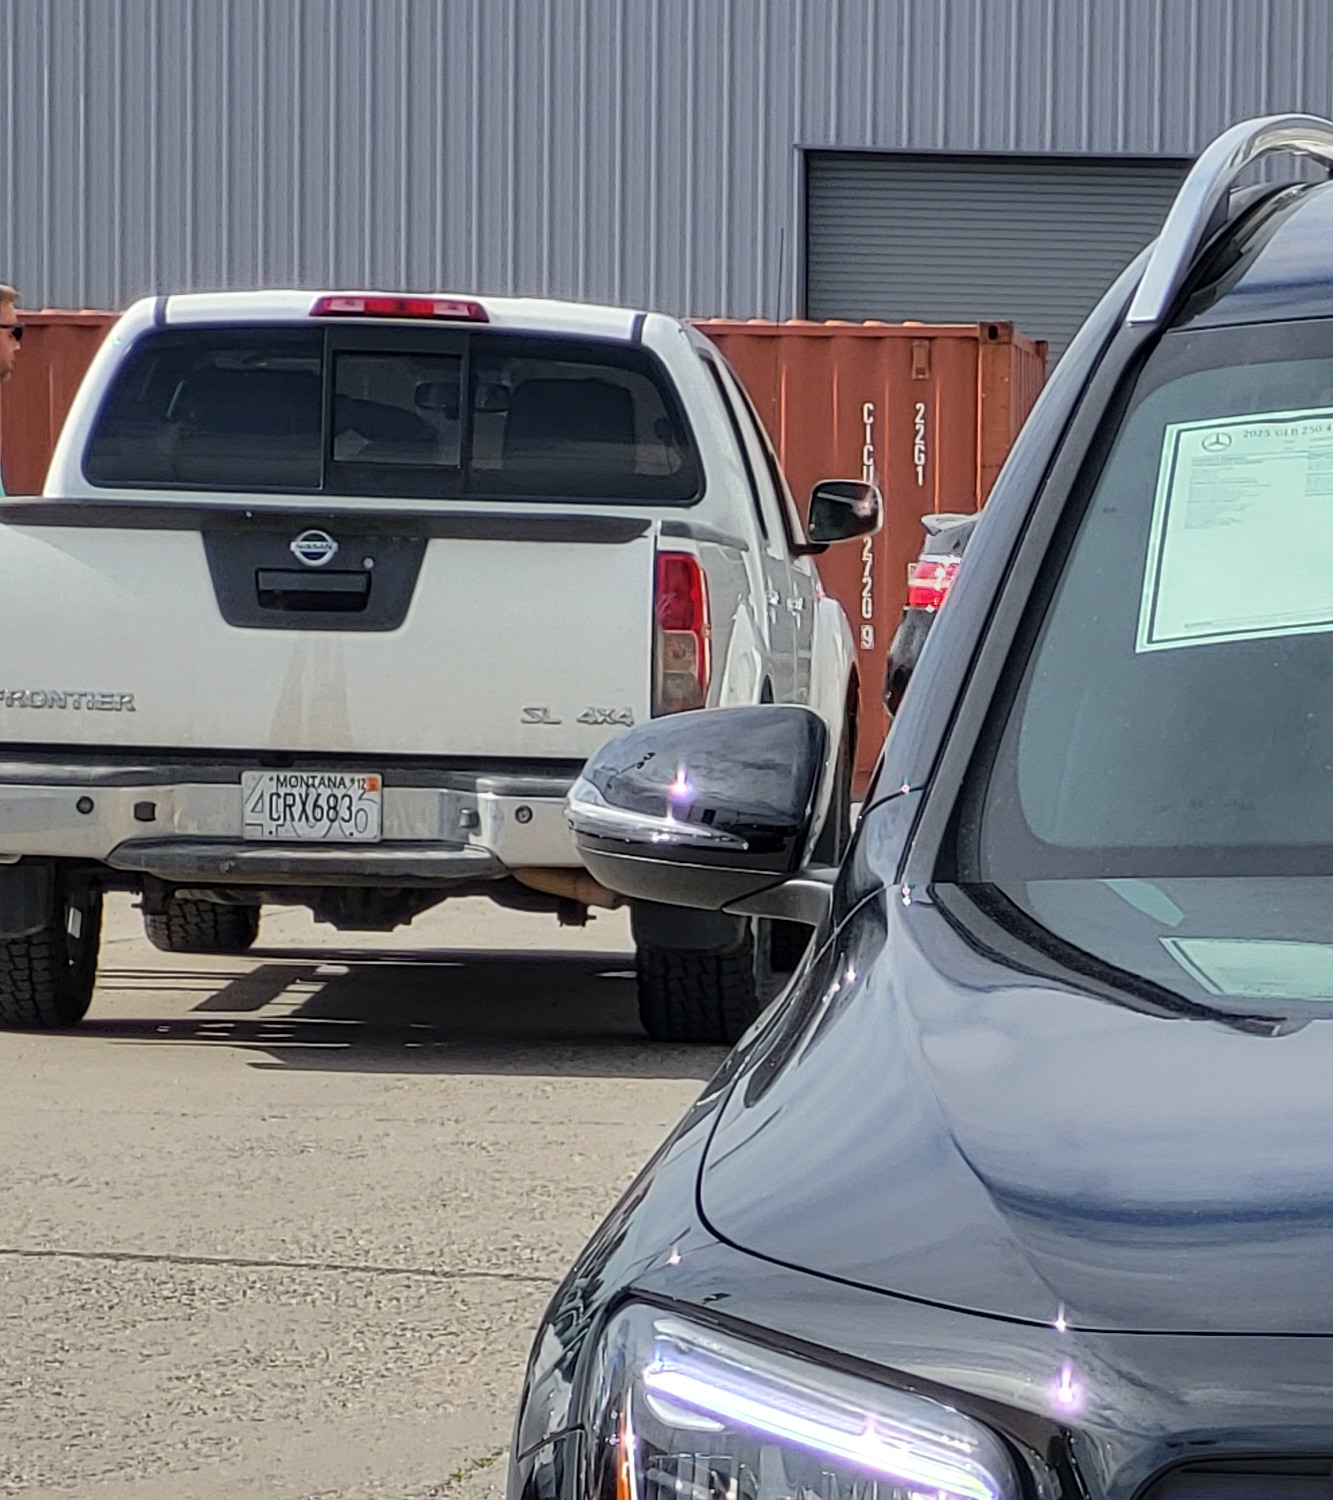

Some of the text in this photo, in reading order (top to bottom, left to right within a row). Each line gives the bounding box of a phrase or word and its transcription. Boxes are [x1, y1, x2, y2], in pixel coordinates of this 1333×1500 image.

[1275, 427, 1299, 438] GLB
[1301, 424, 1323, 435] 250
[862, 403, 874, 484] CICU
[914, 403, 926, 486] 22G1
[0, 689, 137, 712] RONTIER
[520, 706, 562, 725] SL
[276, 774, 347, 789] MONTANA
[269, 792, 353, 823] CRX683
